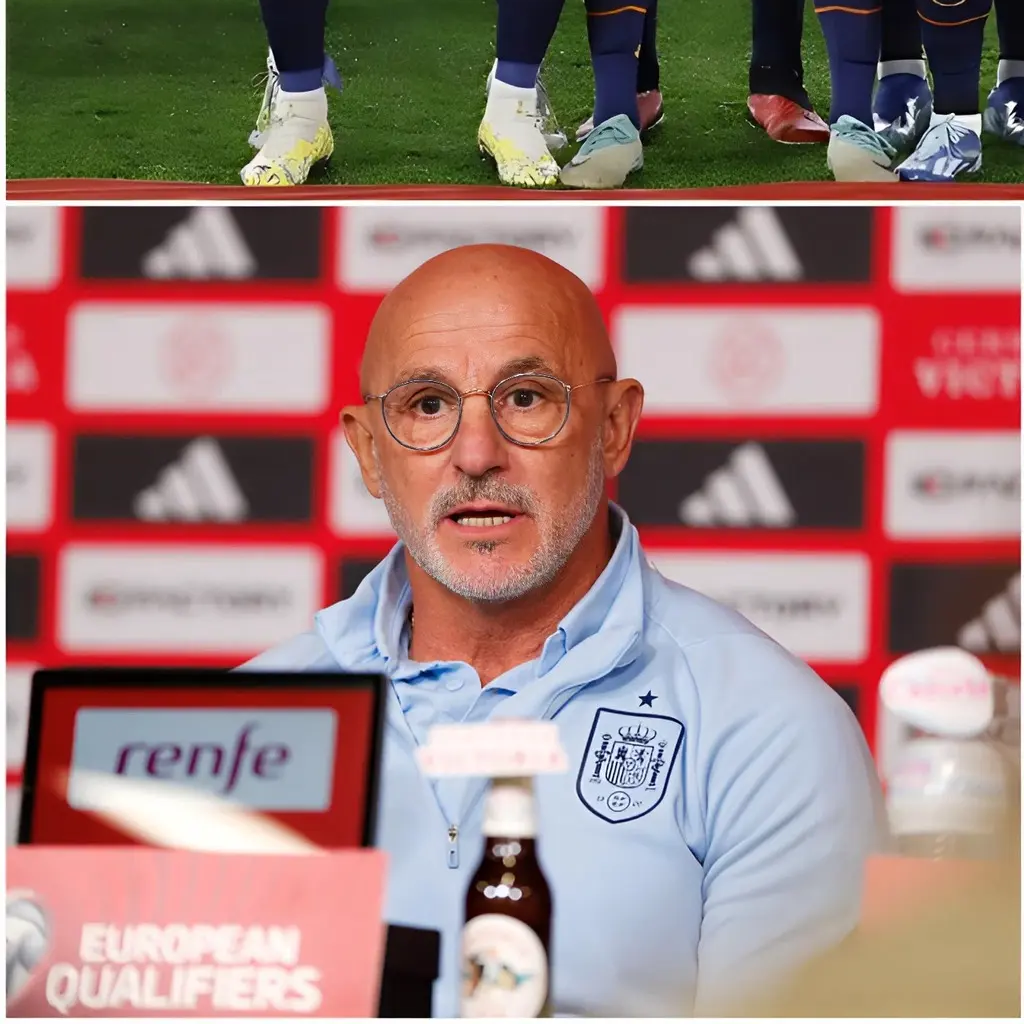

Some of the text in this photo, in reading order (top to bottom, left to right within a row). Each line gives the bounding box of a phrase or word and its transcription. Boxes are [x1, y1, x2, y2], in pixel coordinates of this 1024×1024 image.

[115, 722, 291, 795] renfe
[80, 922, 301, 964] EUROPEAN
[45, 964, 323, 1016] QUALIFIERS
